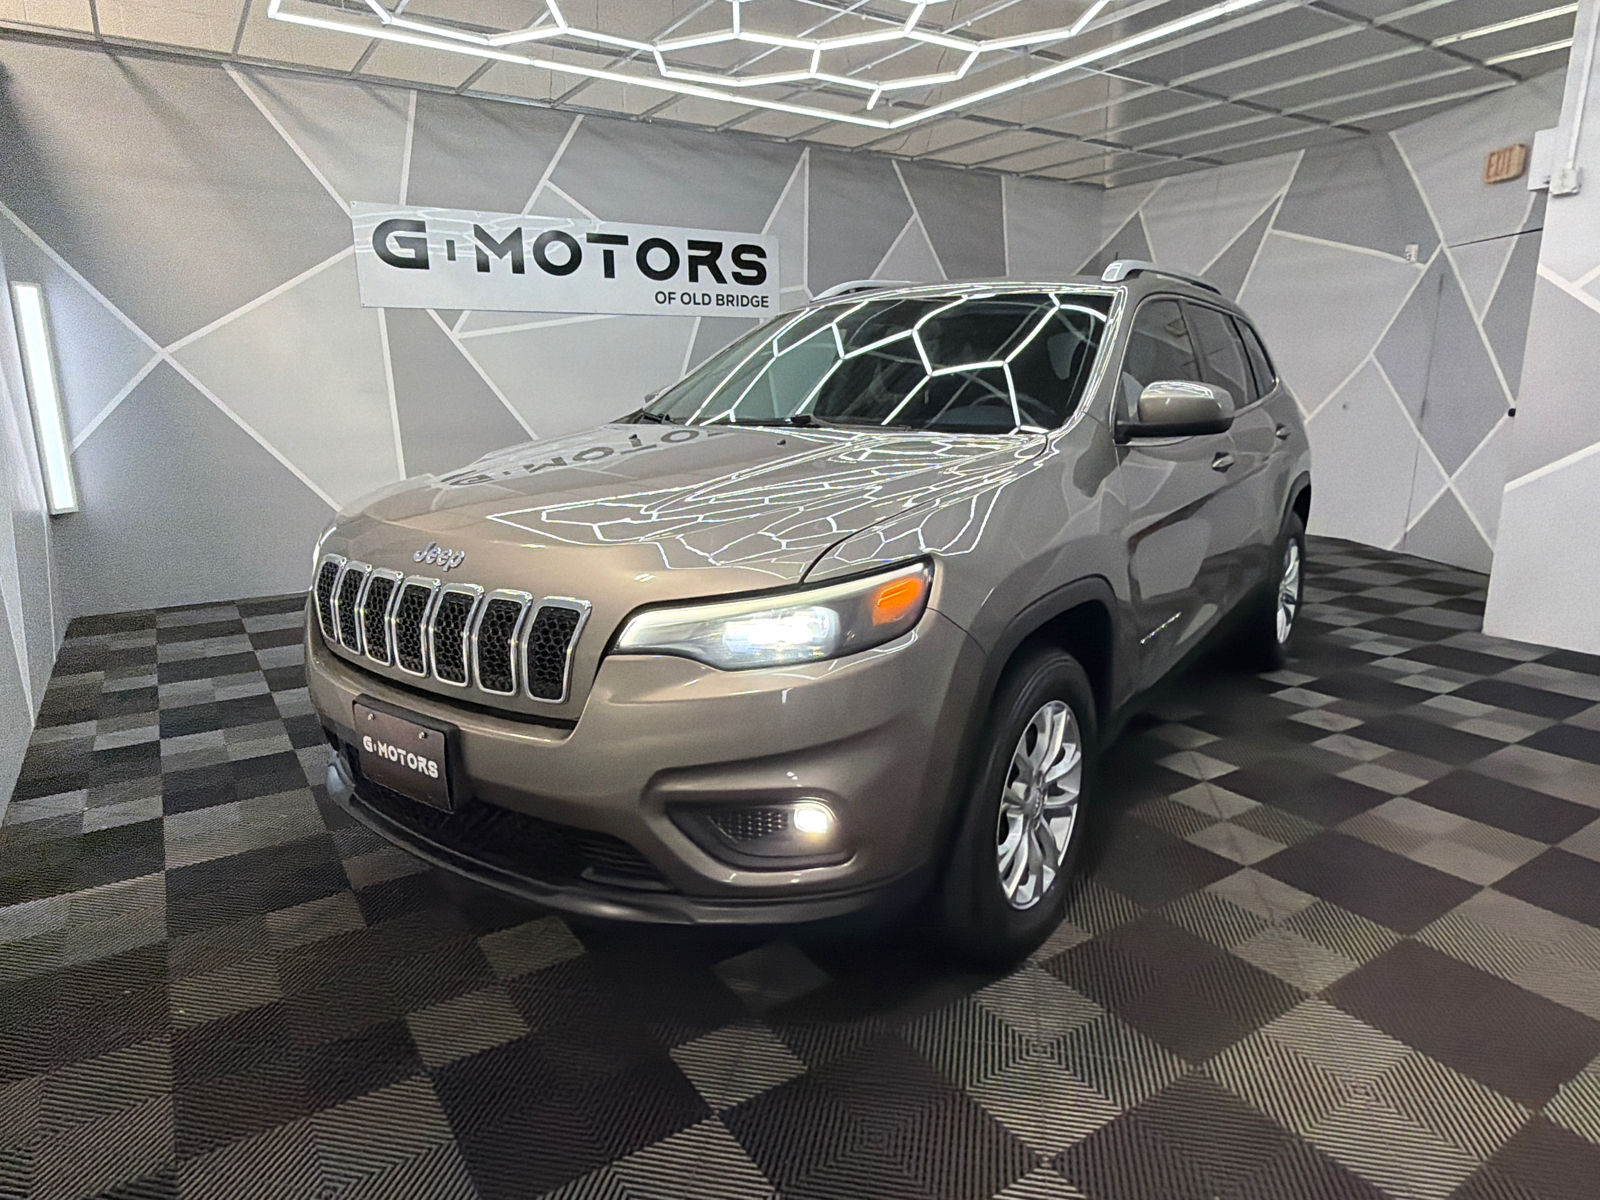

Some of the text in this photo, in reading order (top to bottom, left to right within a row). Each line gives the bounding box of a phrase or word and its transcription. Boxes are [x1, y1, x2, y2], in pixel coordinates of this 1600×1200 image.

[655, 291, 769, 308] OF OLD BRIDGE
[413, 541, 465, 572] Jeep
